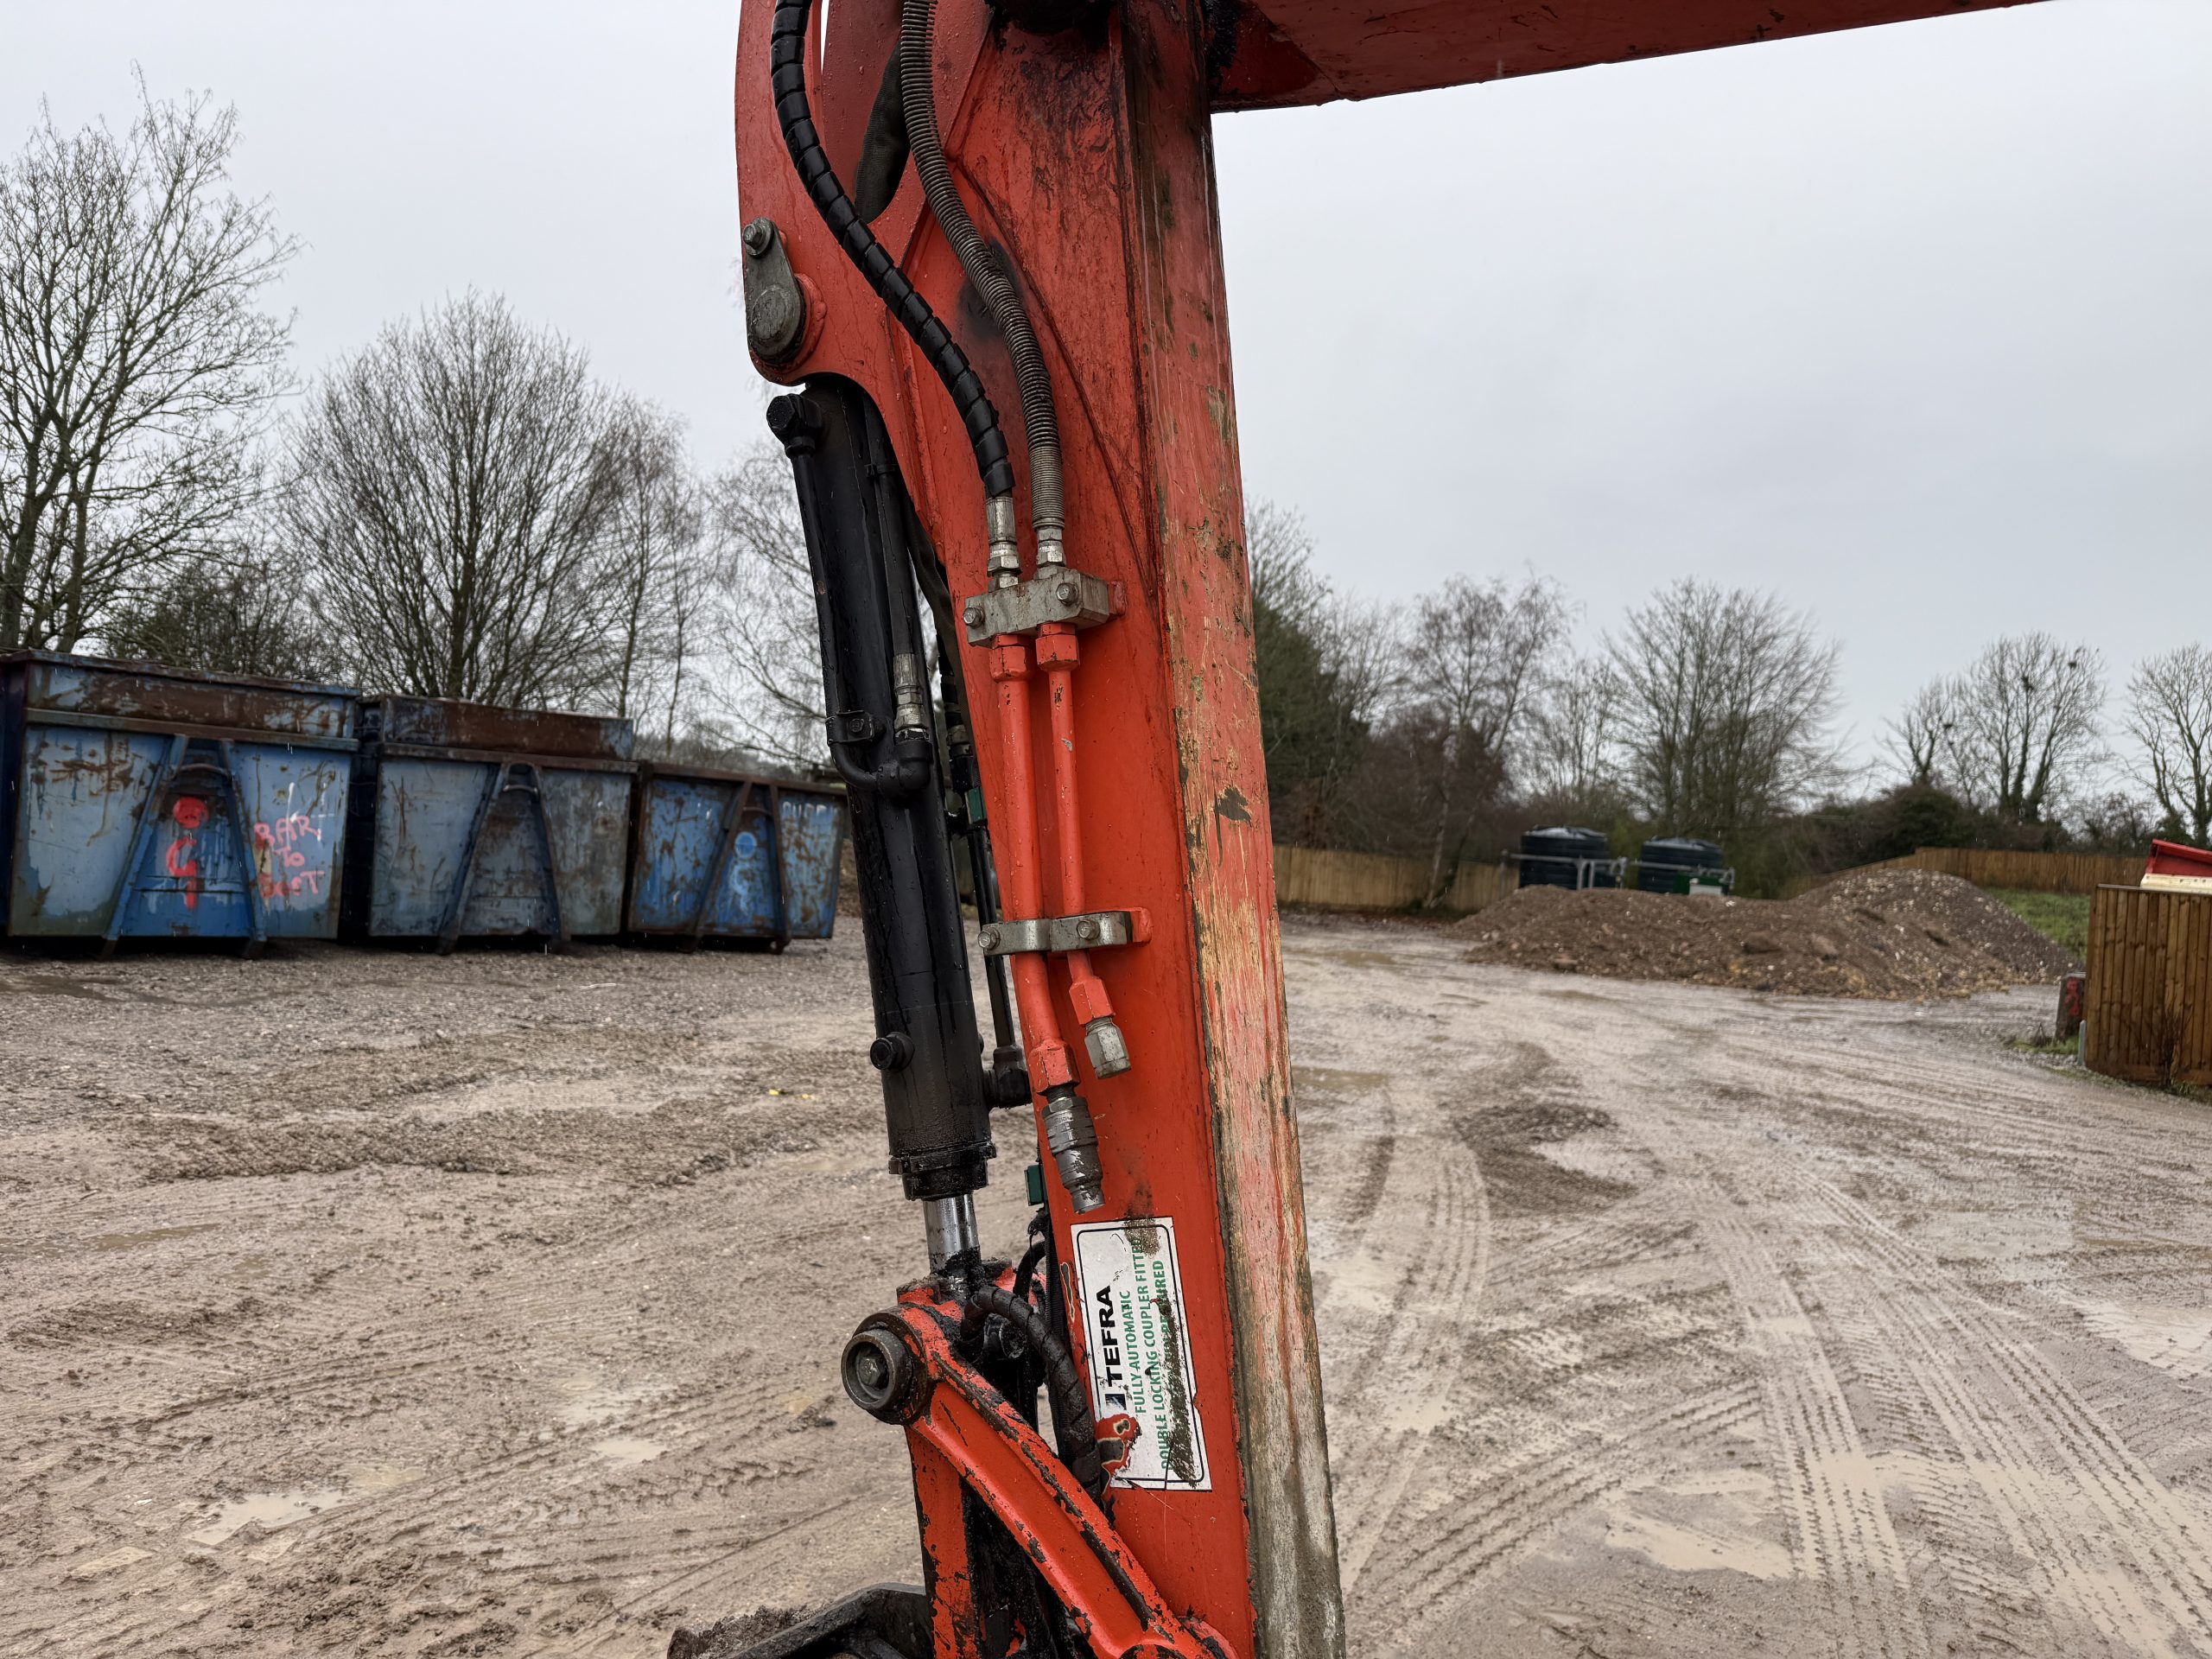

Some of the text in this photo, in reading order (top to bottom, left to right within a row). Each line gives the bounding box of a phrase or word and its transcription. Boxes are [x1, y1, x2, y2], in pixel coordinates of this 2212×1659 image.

[1096, 1285, 1123, 1387] TEFRA
[1119, 1290, 1147, 1414] FULLY AUTOMATIC
[1131, 1239, 1174, 1471] DOUBLE LOCKING COUPLER FITTED
